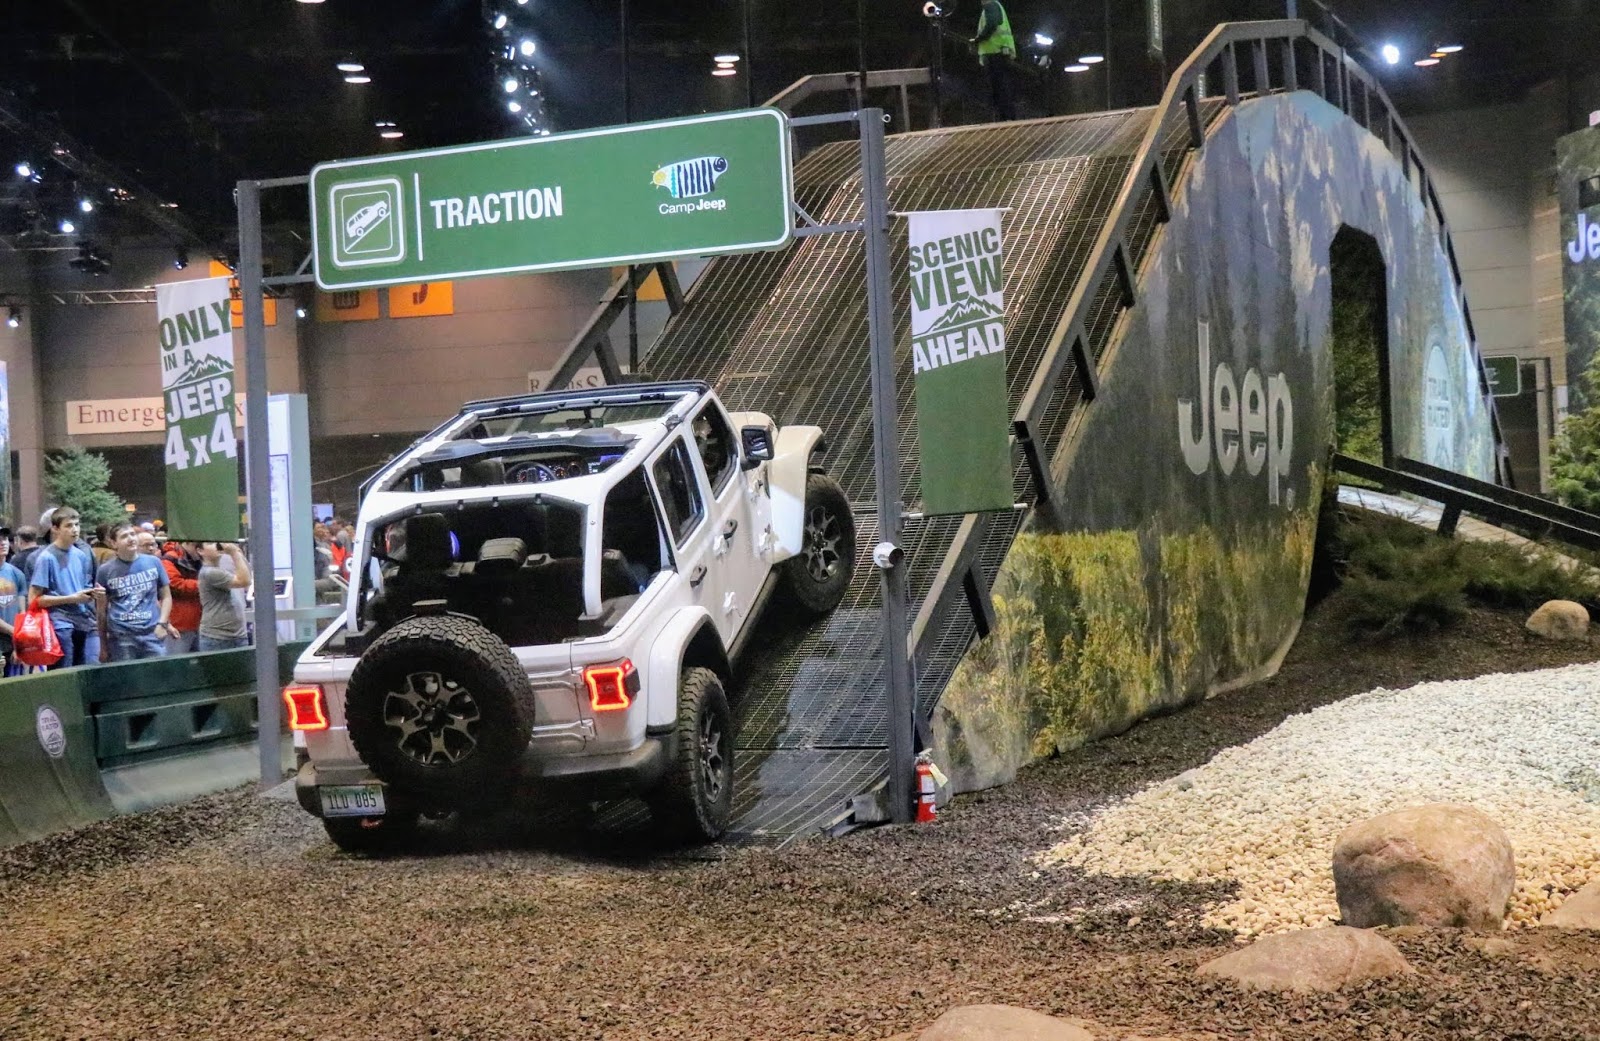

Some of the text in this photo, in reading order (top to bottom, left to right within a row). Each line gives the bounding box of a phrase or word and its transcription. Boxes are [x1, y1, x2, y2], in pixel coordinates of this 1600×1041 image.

[430, 186, 563, 229] TRACTION
[910, 227, 999, 273] SCENIC
[910, 254, 1002, 312] VIEW
[159, 298, 231, 352] ONLY
[912, 322, 1005, 374] AHEAD
[163, 349, 195, 371] IN A
[77, 403, 166, 427] Emerge
[166, 377, 232, 423] JEEP
[1178, 320, 1293, 506] Jeep
[165, 412, 237, 470] 4x4
